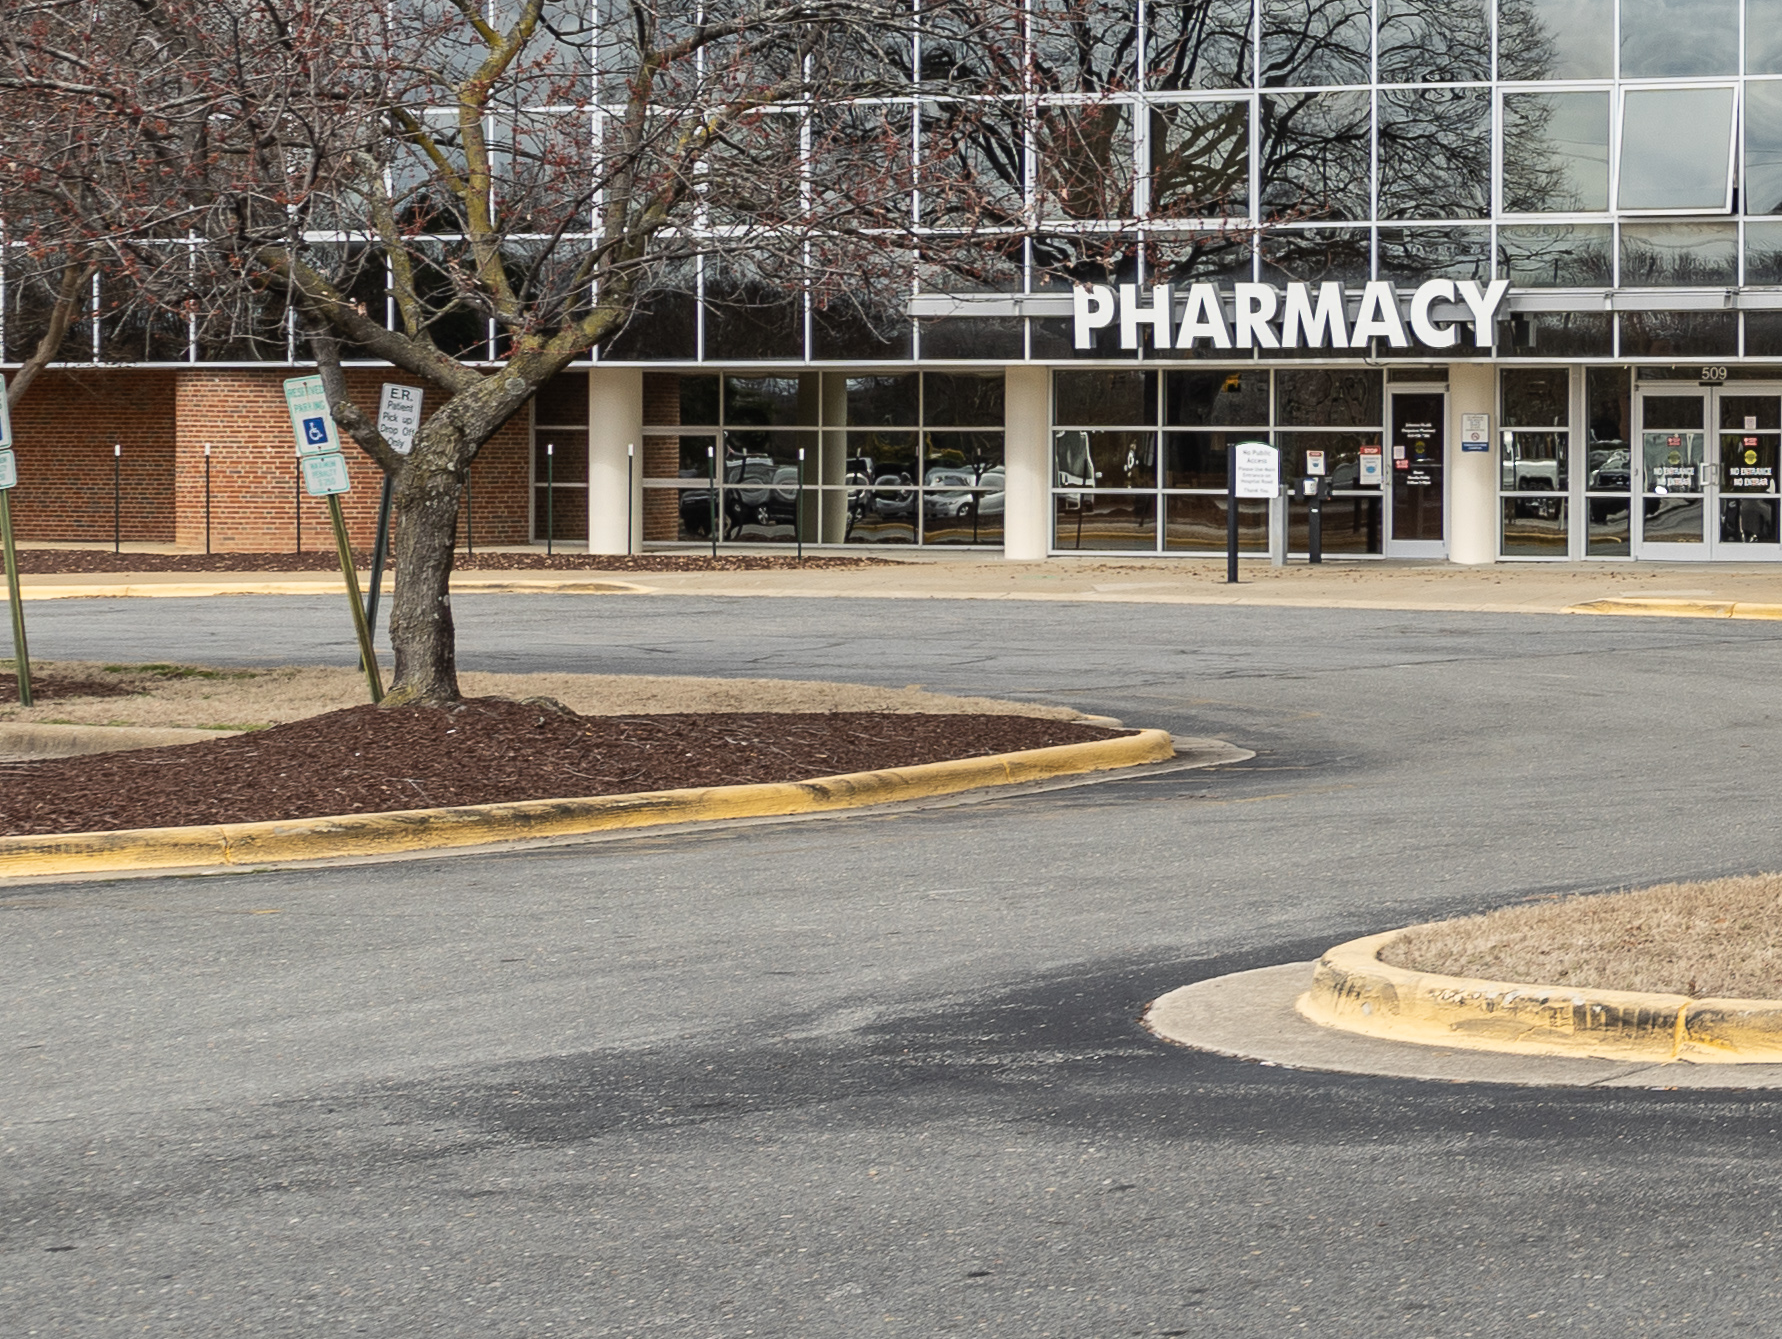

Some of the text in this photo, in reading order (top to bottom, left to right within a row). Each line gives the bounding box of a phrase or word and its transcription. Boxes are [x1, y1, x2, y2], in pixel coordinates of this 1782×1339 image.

[1073, 278, 1512, 350] PHARMACY
[1702, 367, 1727, 380] 509
[390, 387, 414, 401] E.R.
[387, 401, 414, 413] Patient
[383, 412, 413, 425] Pick up
[380, 424, 415, 437] Drop Off
[387, 437, 404, 449] Only
